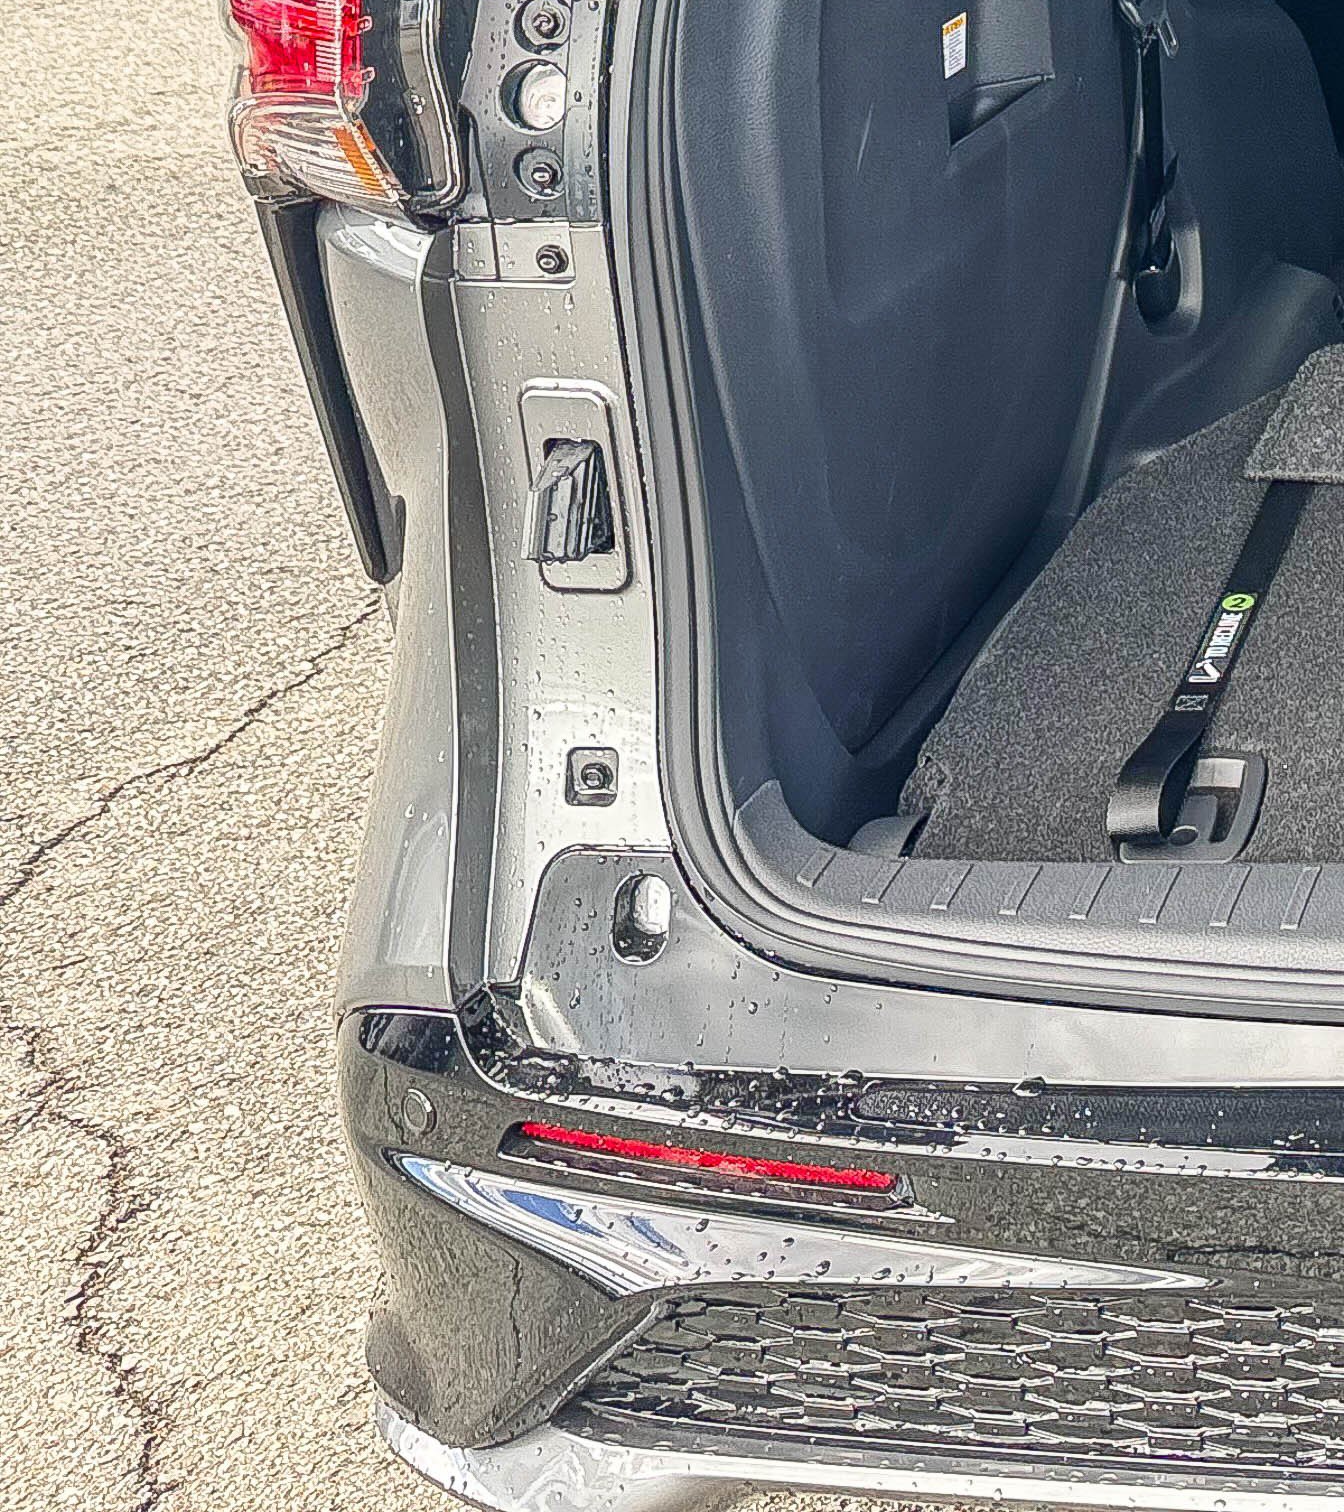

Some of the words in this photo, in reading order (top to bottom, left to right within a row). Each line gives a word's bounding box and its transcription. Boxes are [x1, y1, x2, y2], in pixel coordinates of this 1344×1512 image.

[1228, 596, 1247, 609] 2
[1208, 612, 1244, 646] RECLINE
[1203, 646, 1229, 659] TO
